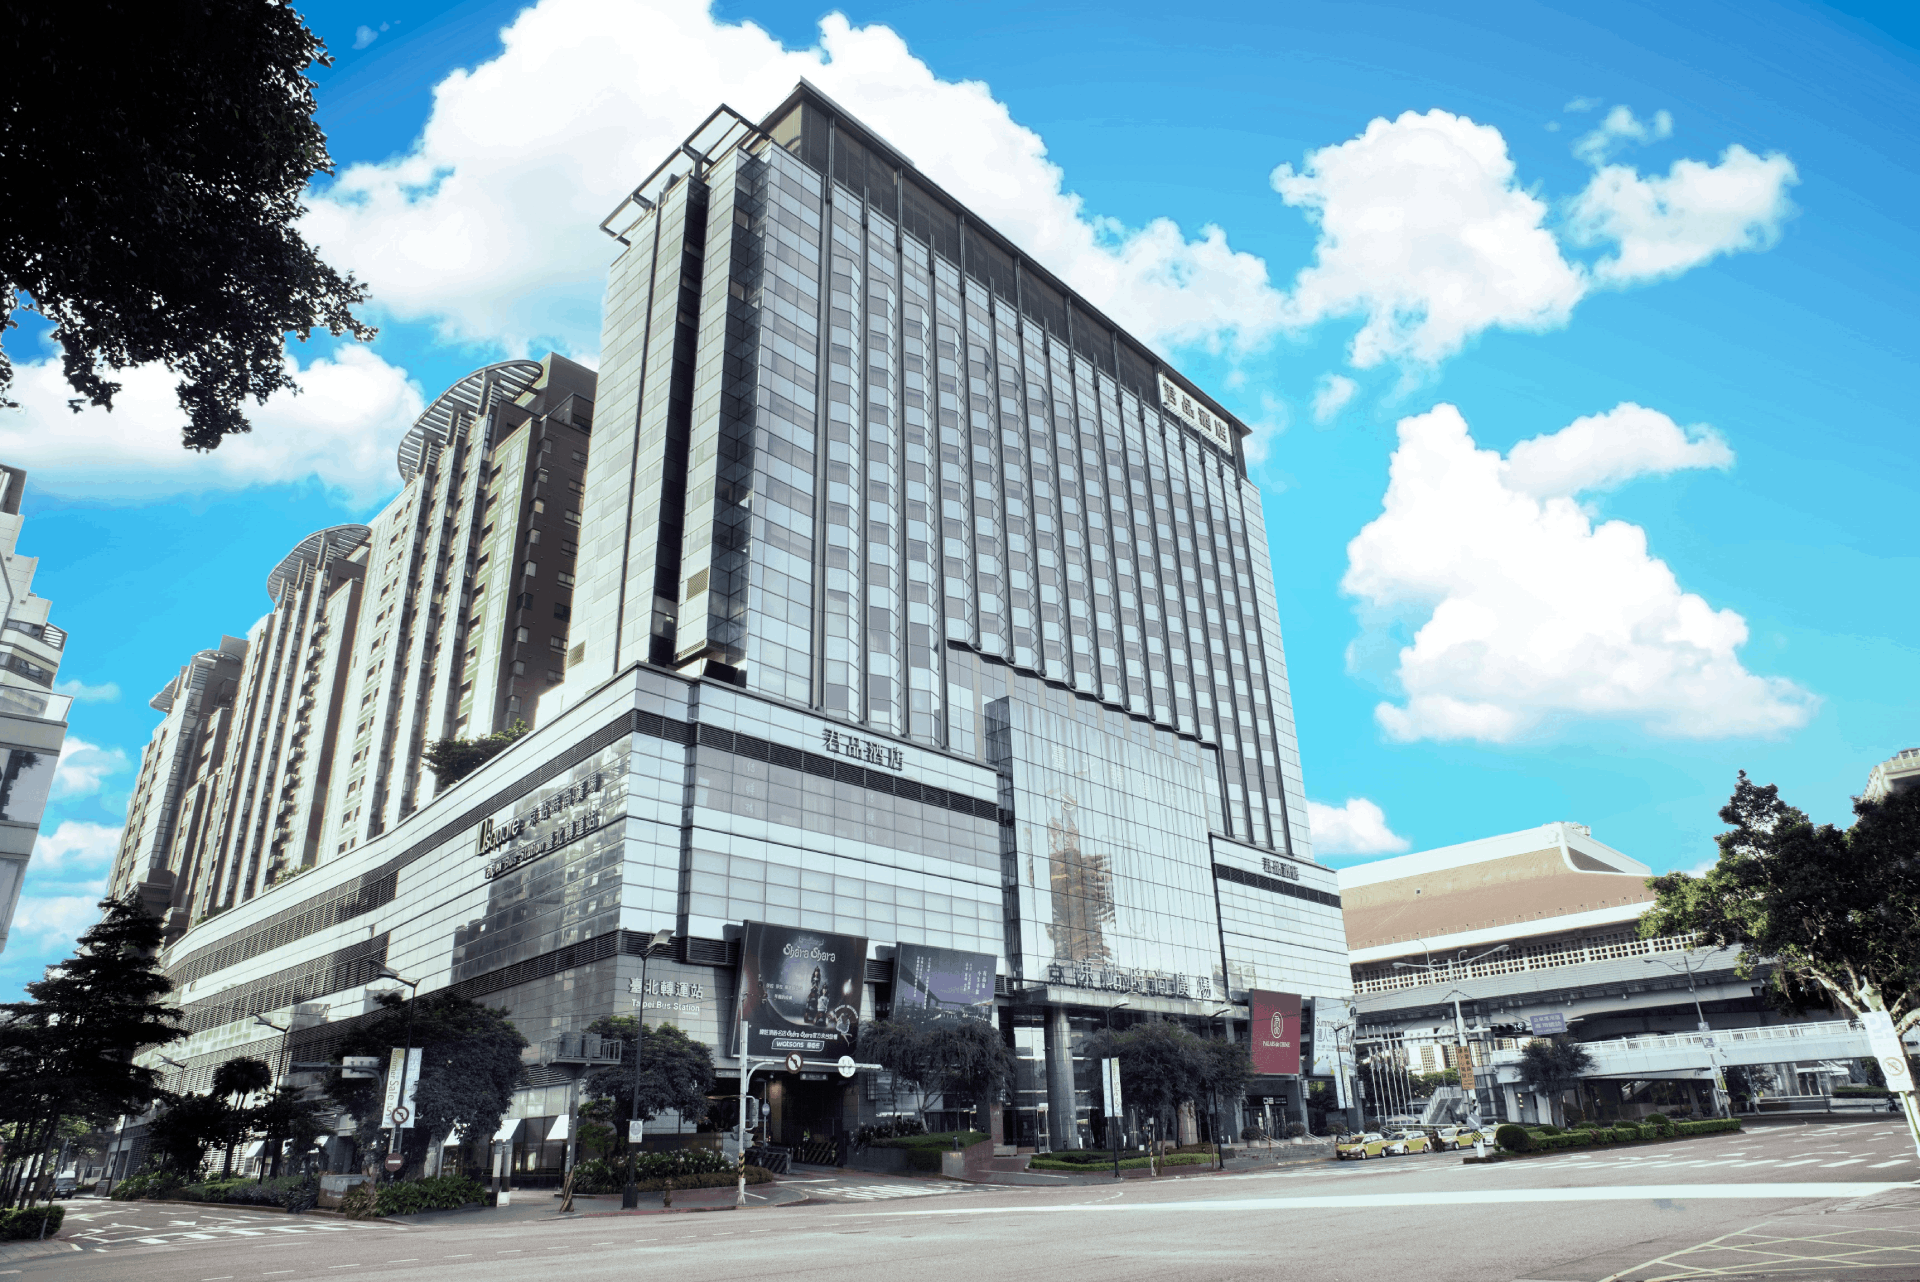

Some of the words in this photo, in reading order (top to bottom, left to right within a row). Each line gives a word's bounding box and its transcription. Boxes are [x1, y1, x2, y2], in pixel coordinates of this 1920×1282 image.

[821, 727, 905, 772] 君品酒店
[529, 773, 601, 827] 京站時尚廣場
[504, 855, 518, 870] Bus
[519, 841, 547, 863] Station
[546, 808, 600, 851] 臺北轉運站
[783, 943, 810, 958] Shara
[810, 947, 836, 962] Shara
[628, 977, 704, 1000] 臺北轉運站
[1079, 957, 1213, 999] 京站時尚廣場
[631, 998, 655, 1009] Taipei
[656, 1001, 671, 1010] Bus
[673, 1002, 700, 1012] Station
[1316, 1016, 1336, 1027] Summer
[776, 1040, 805, 1048] watsons
[391, 1049, 400, 1079] Summer
[387, 1080, 399, 1101] Sale
